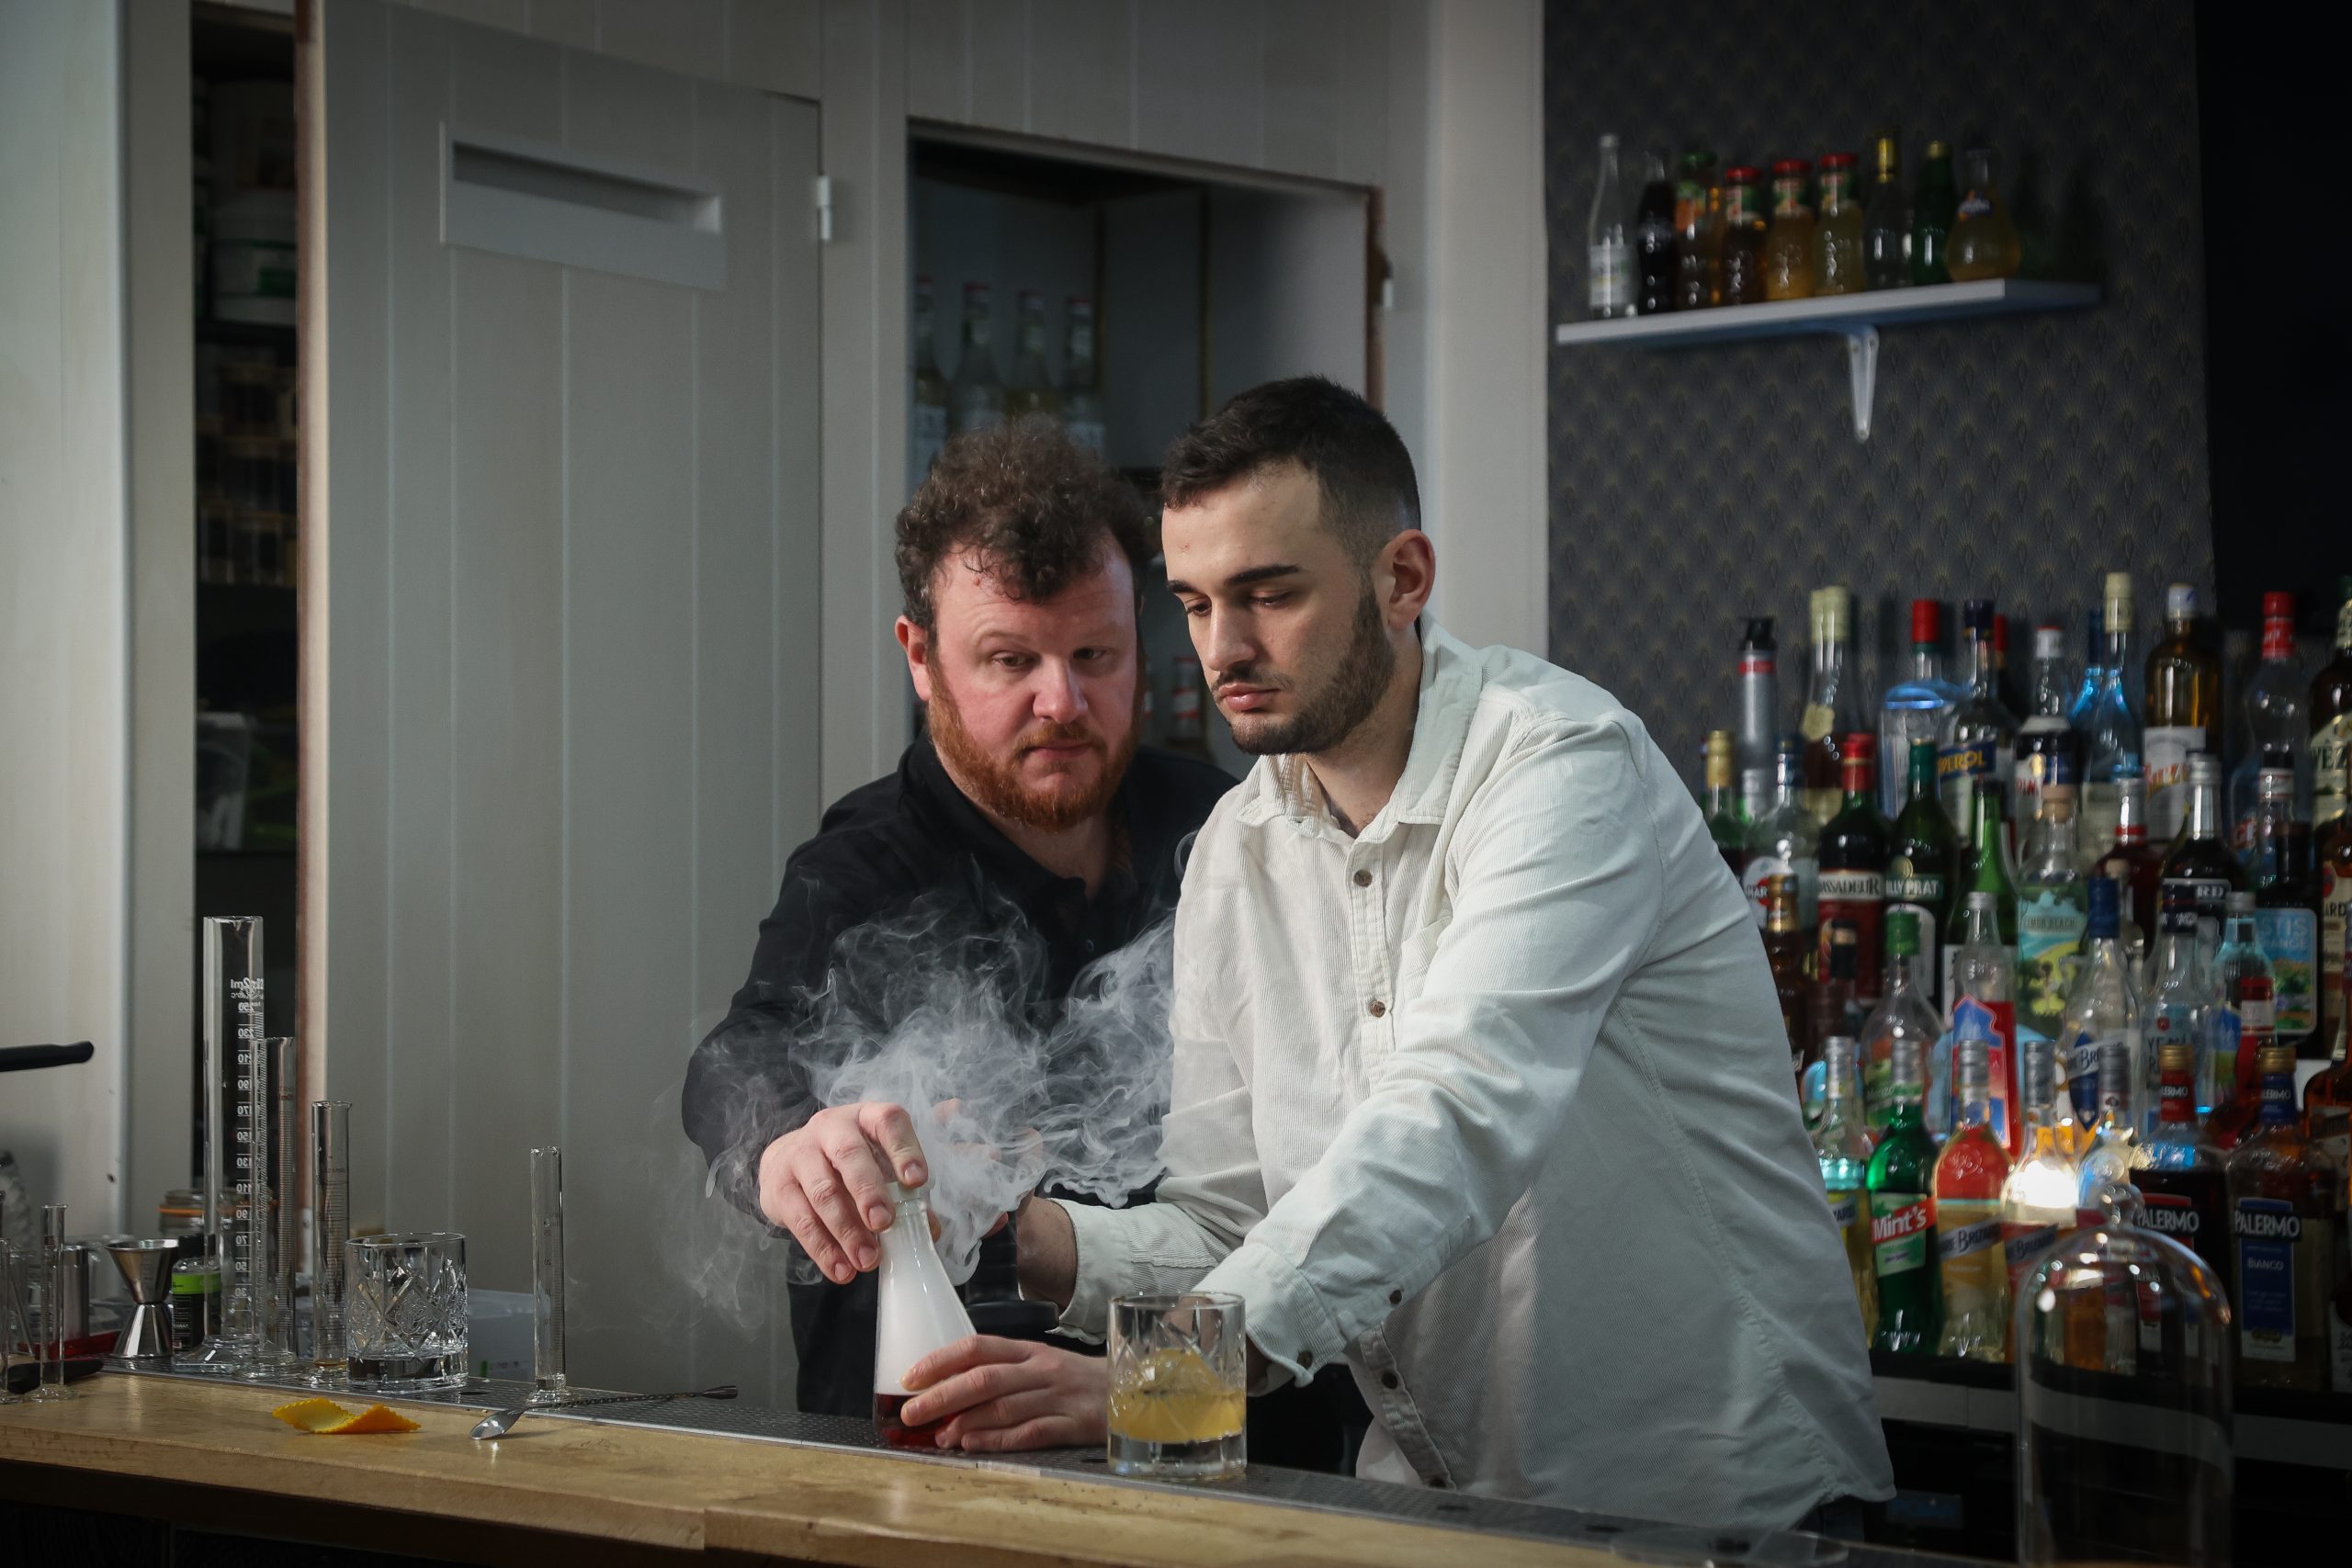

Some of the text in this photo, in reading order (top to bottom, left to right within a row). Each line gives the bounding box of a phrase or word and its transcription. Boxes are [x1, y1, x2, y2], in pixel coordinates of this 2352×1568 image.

[1905, 879, 1939, 896] PRAT
[1873, 1206, 1927, 1242] Mint's
[2137, 1208, 2199, 1233] PALERMO
[2234, 1210, 2301, 1238] PALERMO
[2247, 1257, 2285, 1271] BIANCO
